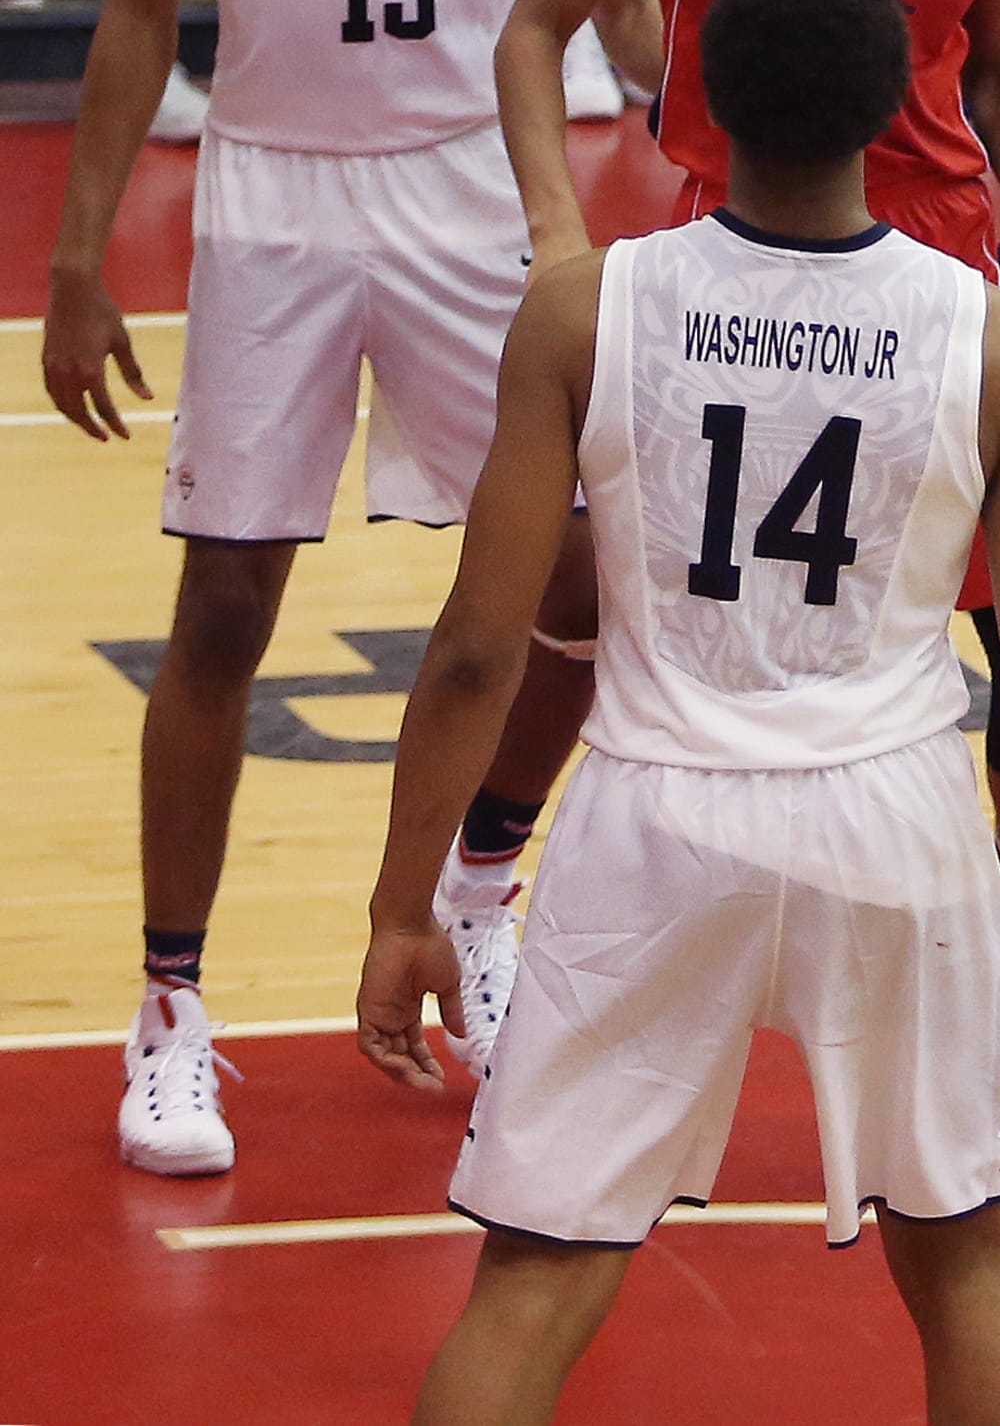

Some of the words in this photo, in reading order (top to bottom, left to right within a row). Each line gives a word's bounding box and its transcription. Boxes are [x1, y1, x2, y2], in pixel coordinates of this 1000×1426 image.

[685, 311, 860, 377] WASHINGTON
[864, 329, 899, 380] JR
[687, 403, 862, 606] 14
